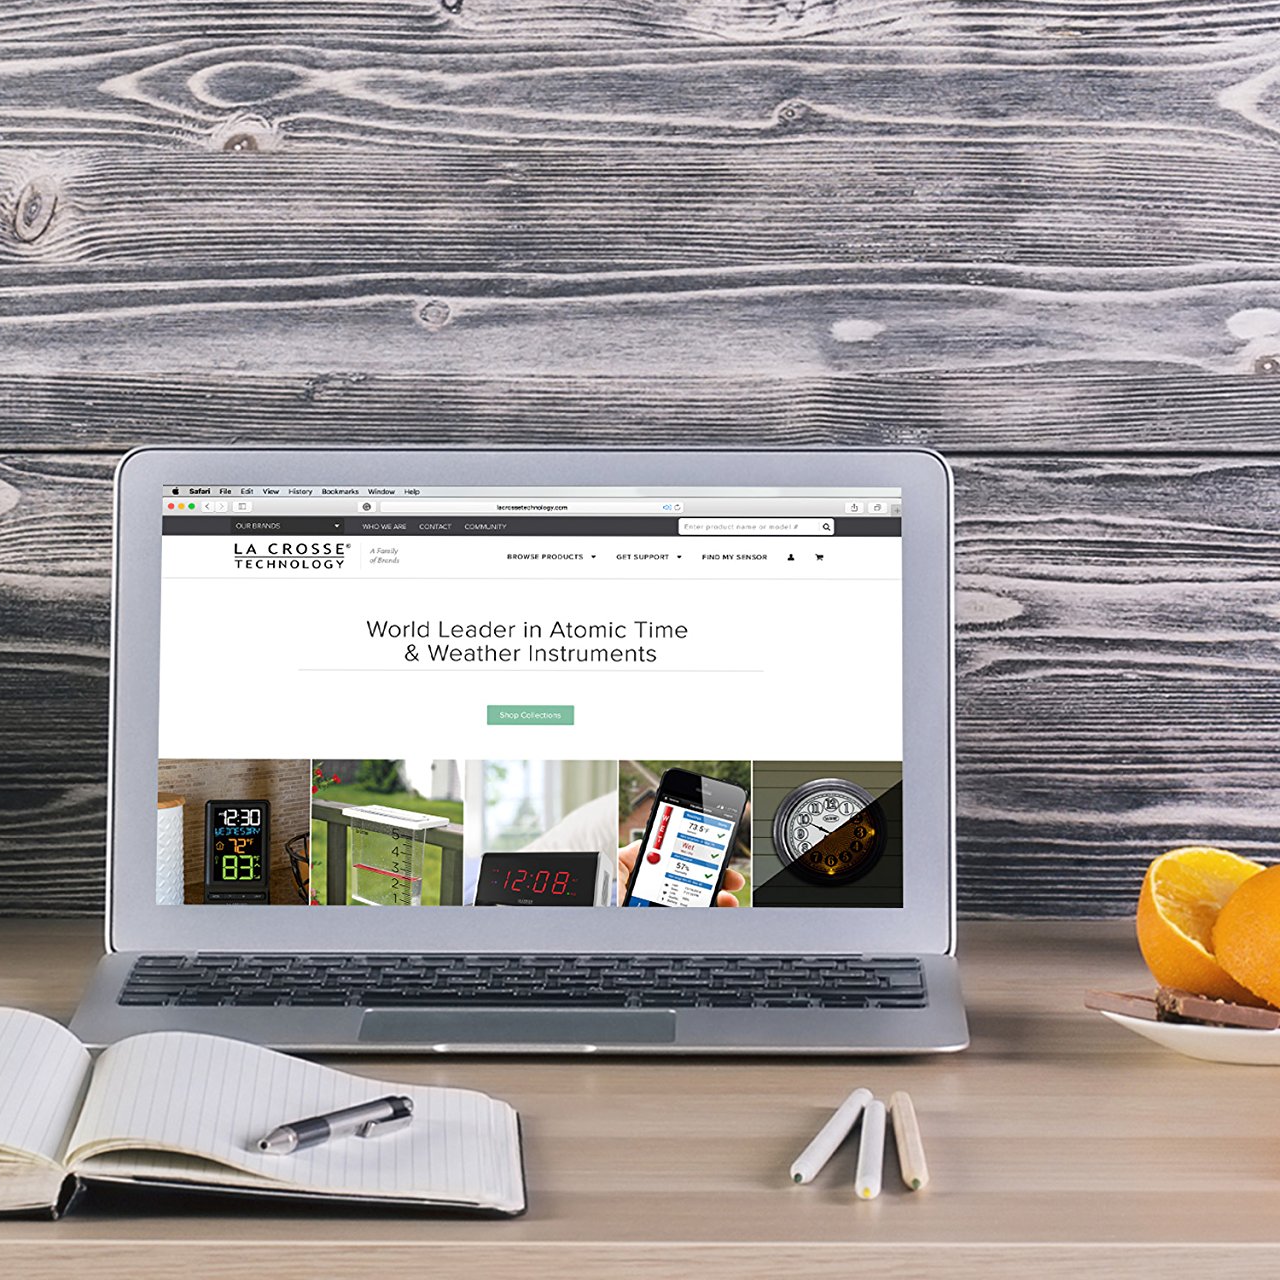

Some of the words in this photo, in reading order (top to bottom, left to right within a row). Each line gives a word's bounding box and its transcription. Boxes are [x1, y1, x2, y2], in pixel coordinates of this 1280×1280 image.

[234, 543, 256, 554] LA
[234, 560, 344, 569] TECHNOLOGY
[367, 620, 430, 638] World
[439, 620, 516, 639] Leader
[523, 621, 542, 639] in
[549, 621, 627, 639] Atomic
[634, 621, 688, 639] Time
[404, 644, 419, 662] &
[428, 644, 520, 662] Weather
[529, 645, 657, 662] Instruments
[224, 809, 260, 826] 12:30
[392, 828, 400, 840] 5
[392, 846, 399, 857] 4
[392, 862, 399, 873] 3
[392, 878, 399, 889] 2
[504, 870, 570, 894] 12:08
[393, 894, 397, 903] 1
